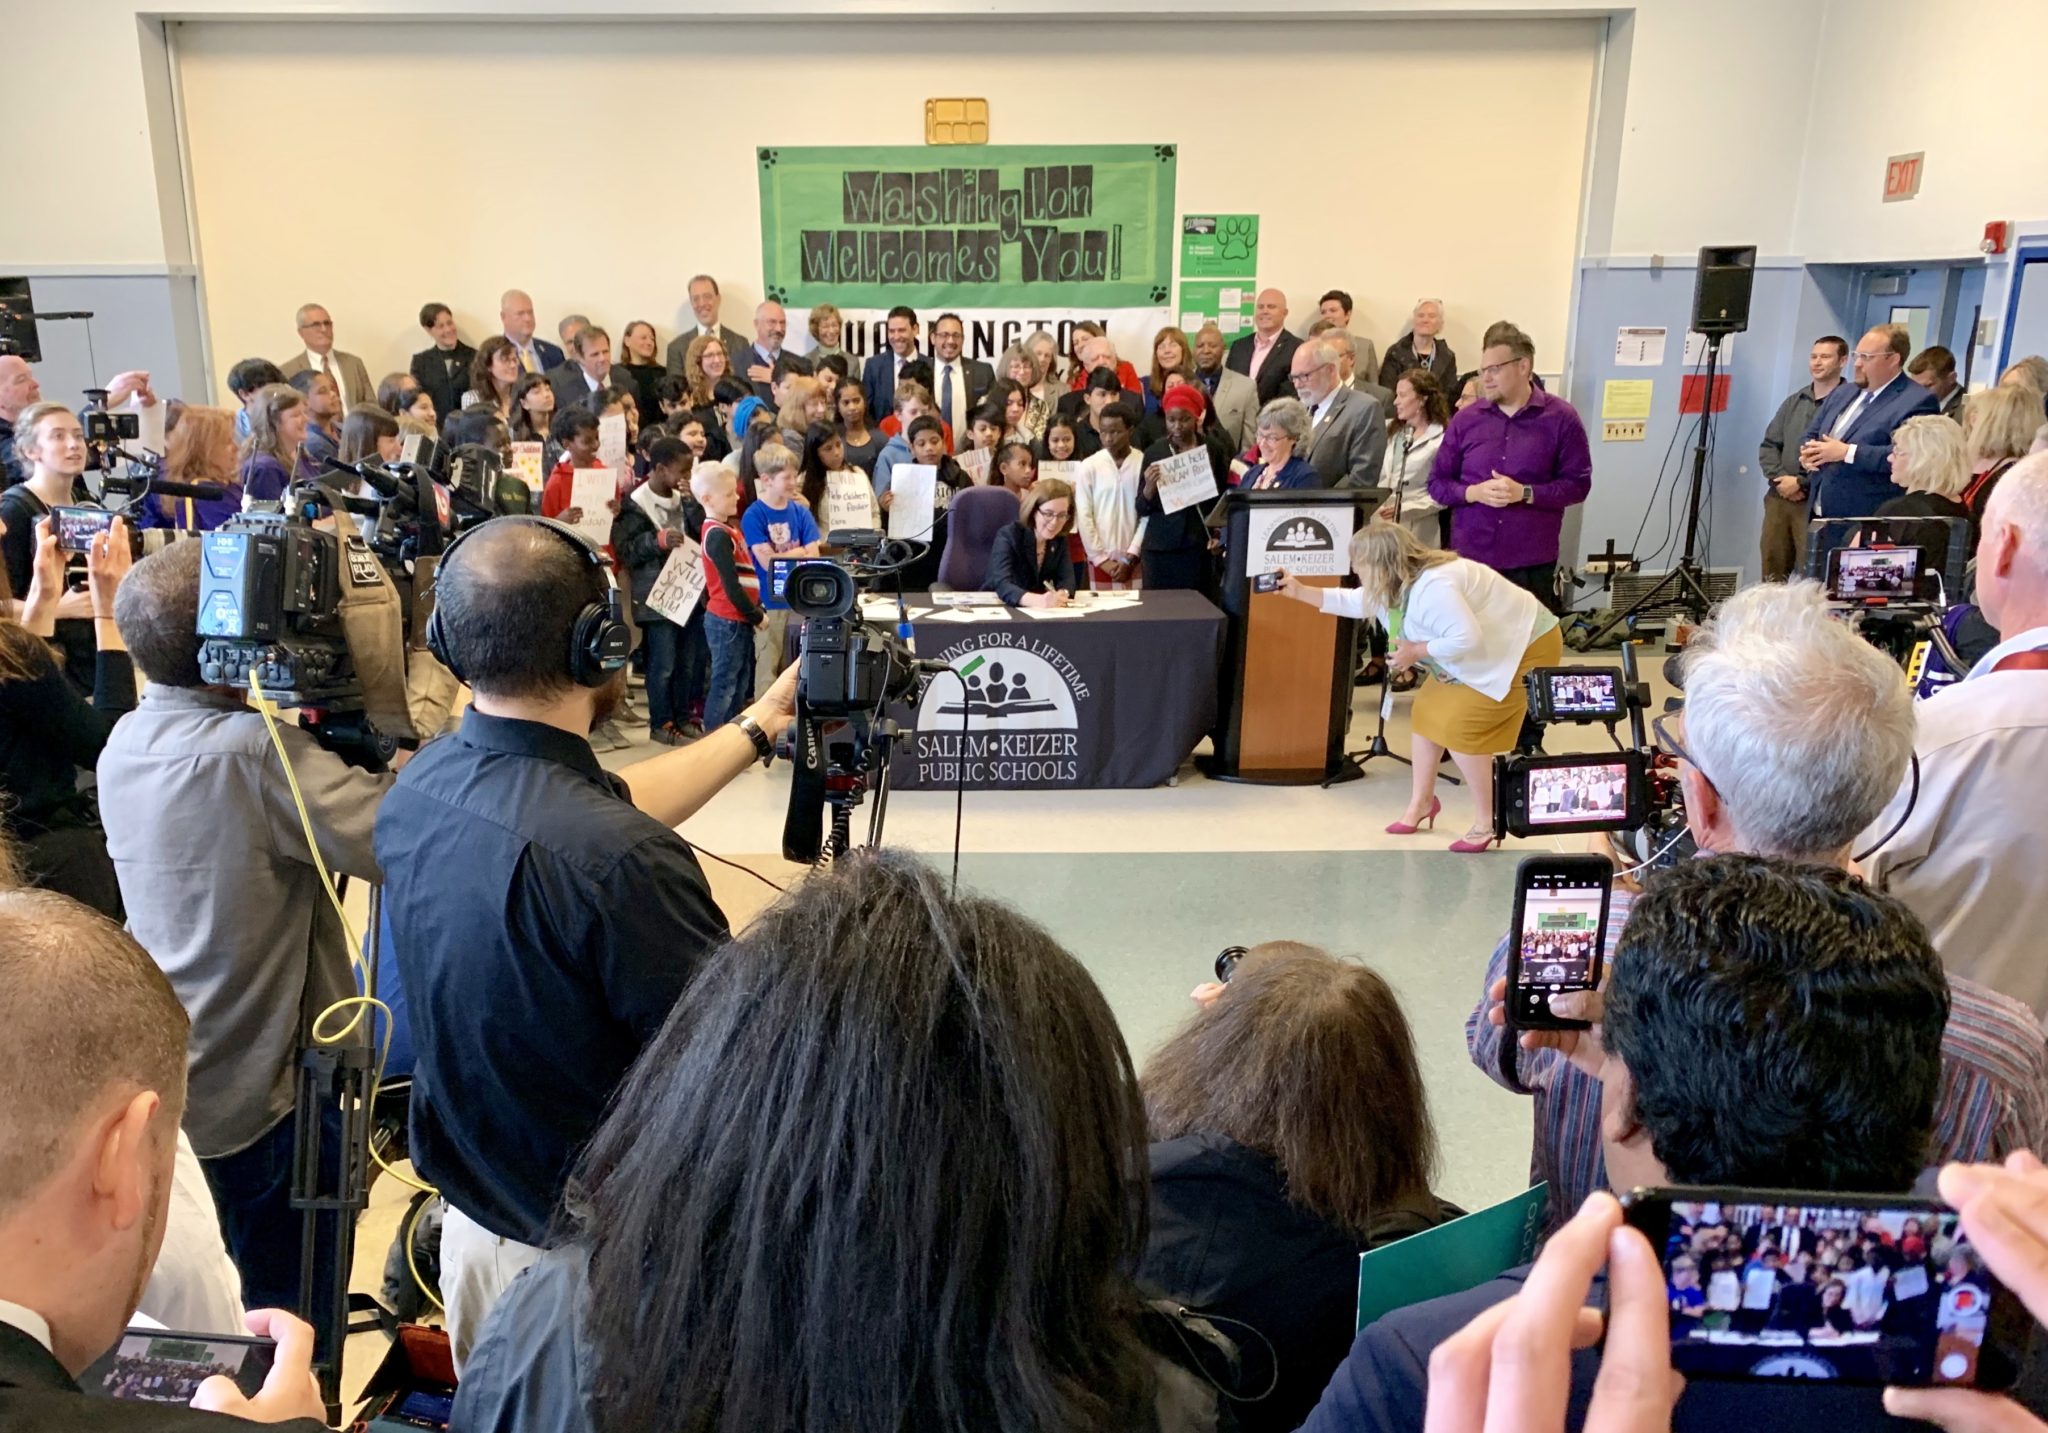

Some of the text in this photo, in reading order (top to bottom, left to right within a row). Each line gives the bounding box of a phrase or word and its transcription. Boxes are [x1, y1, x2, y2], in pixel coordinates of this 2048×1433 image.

[1887, 158, 1920, 195] EXIT
[801, 225, 1121, 282] Welcomes You!
[1296, 565, 1334, 574] SCHOOLS
[978, 632, 1012, 648] FOR
[1015, 634, 1027, 649] A
[1030, 639, 1090, 701] LIFETIME
[805, 719, 818, 769] Canon
[919, 760, 1077, 782] PUBLIC SCHOOLS
